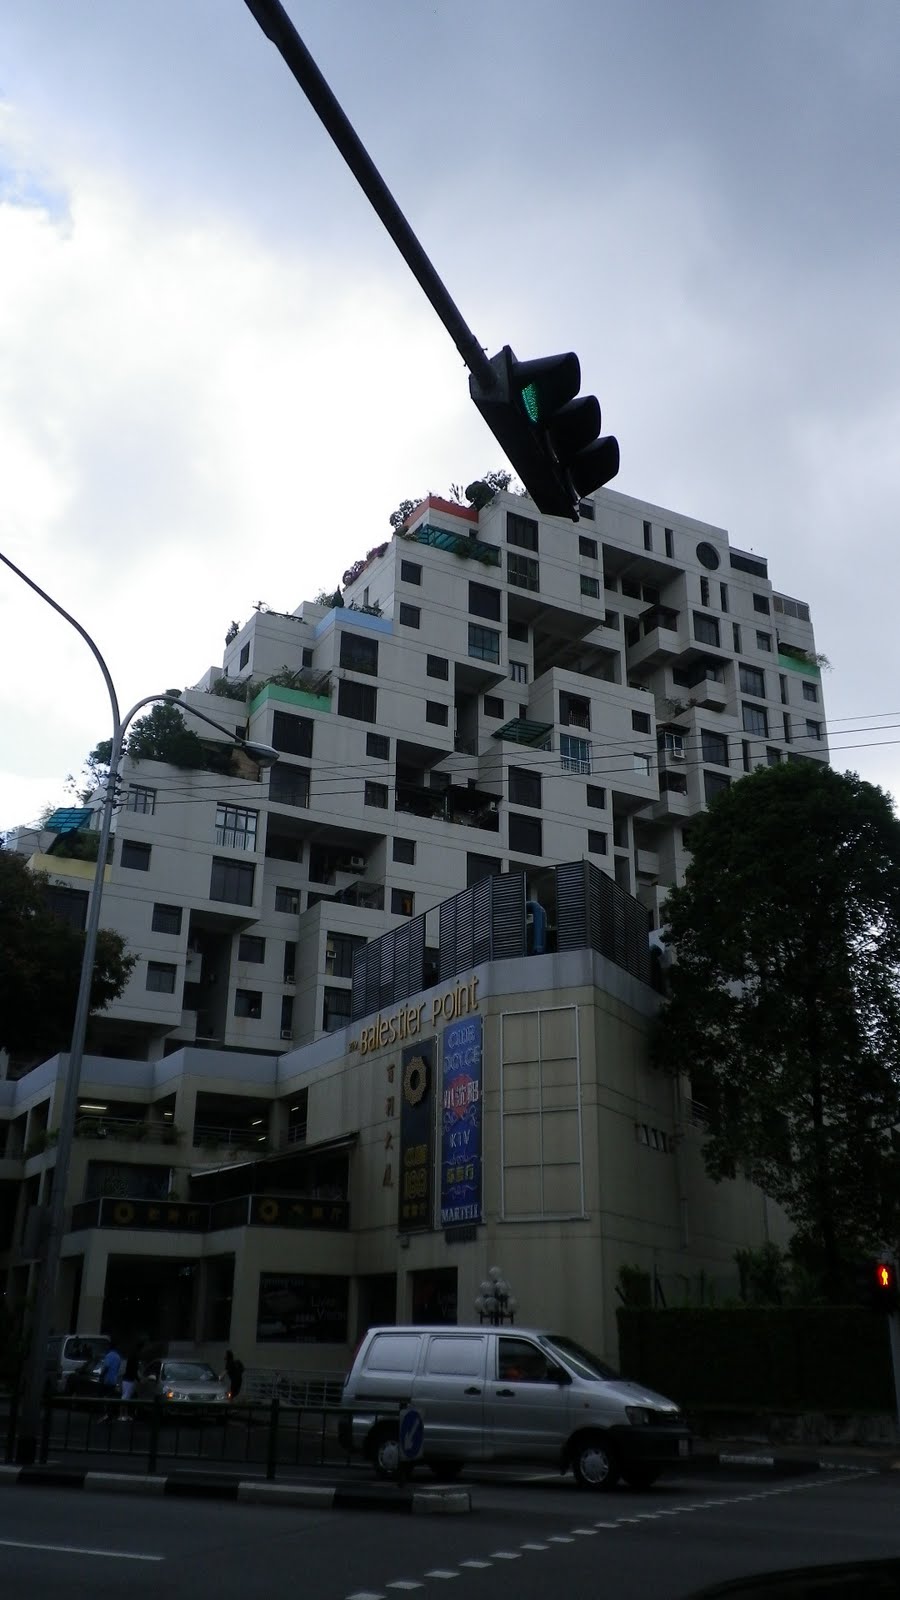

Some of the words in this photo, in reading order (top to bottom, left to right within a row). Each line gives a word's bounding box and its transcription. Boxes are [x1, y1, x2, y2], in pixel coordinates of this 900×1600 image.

[360, 1002, 427, 1056] Balestier
[449, 1128, 471, 1148] KTV
[441, 1203, 479, 1223] MARTELL
